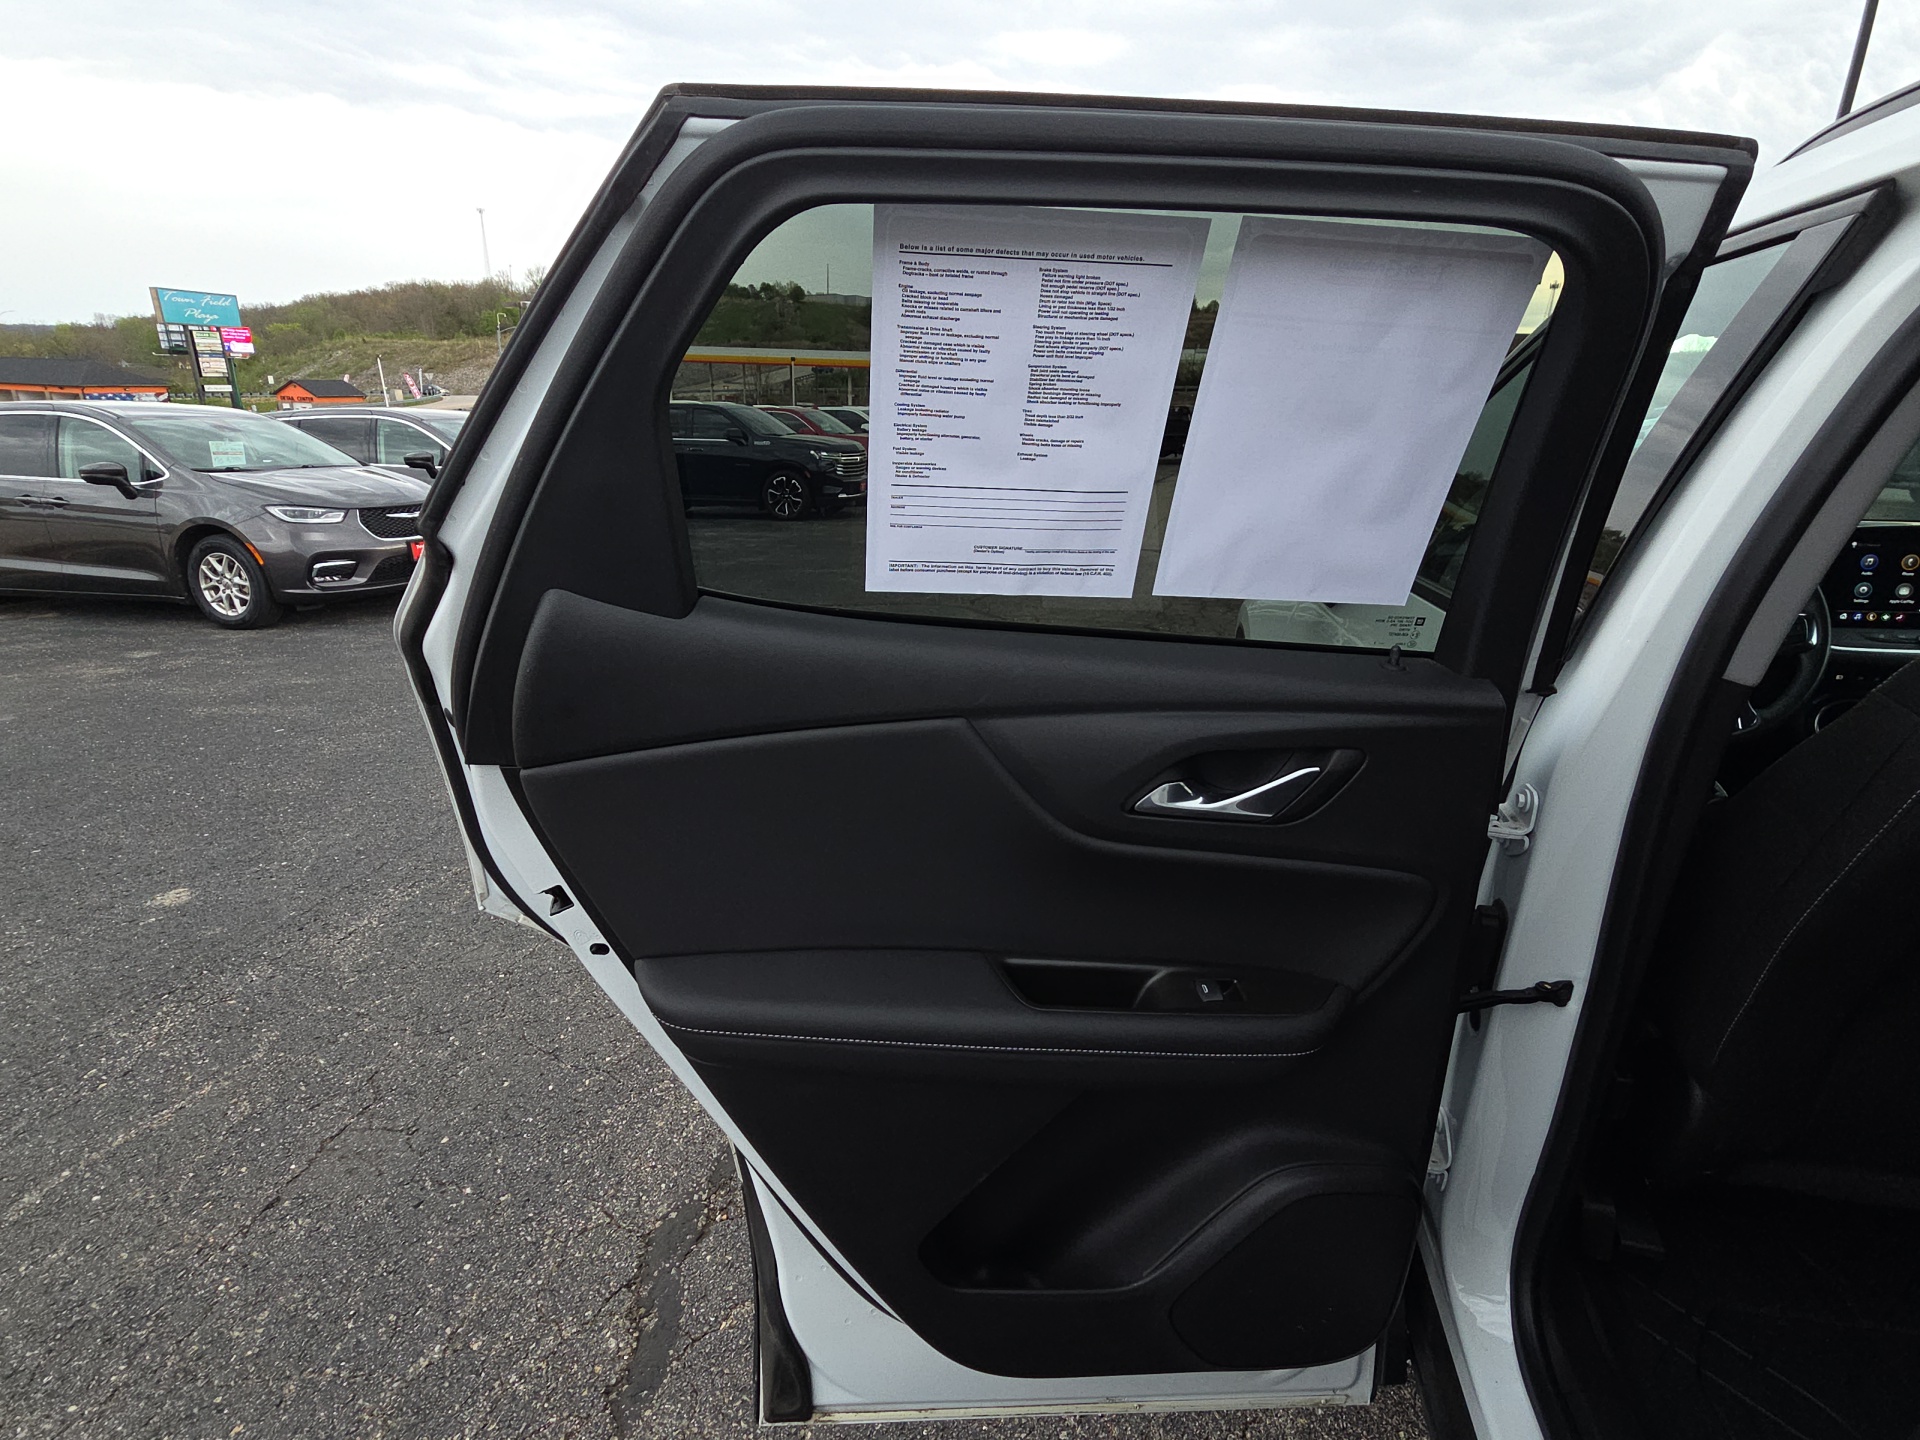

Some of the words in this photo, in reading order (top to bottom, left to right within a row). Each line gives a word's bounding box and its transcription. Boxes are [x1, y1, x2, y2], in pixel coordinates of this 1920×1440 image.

[164, 290, 196, 304] Town
[200, 295, 232, 306] Field
[184, 308, 219, 324] Plaza
